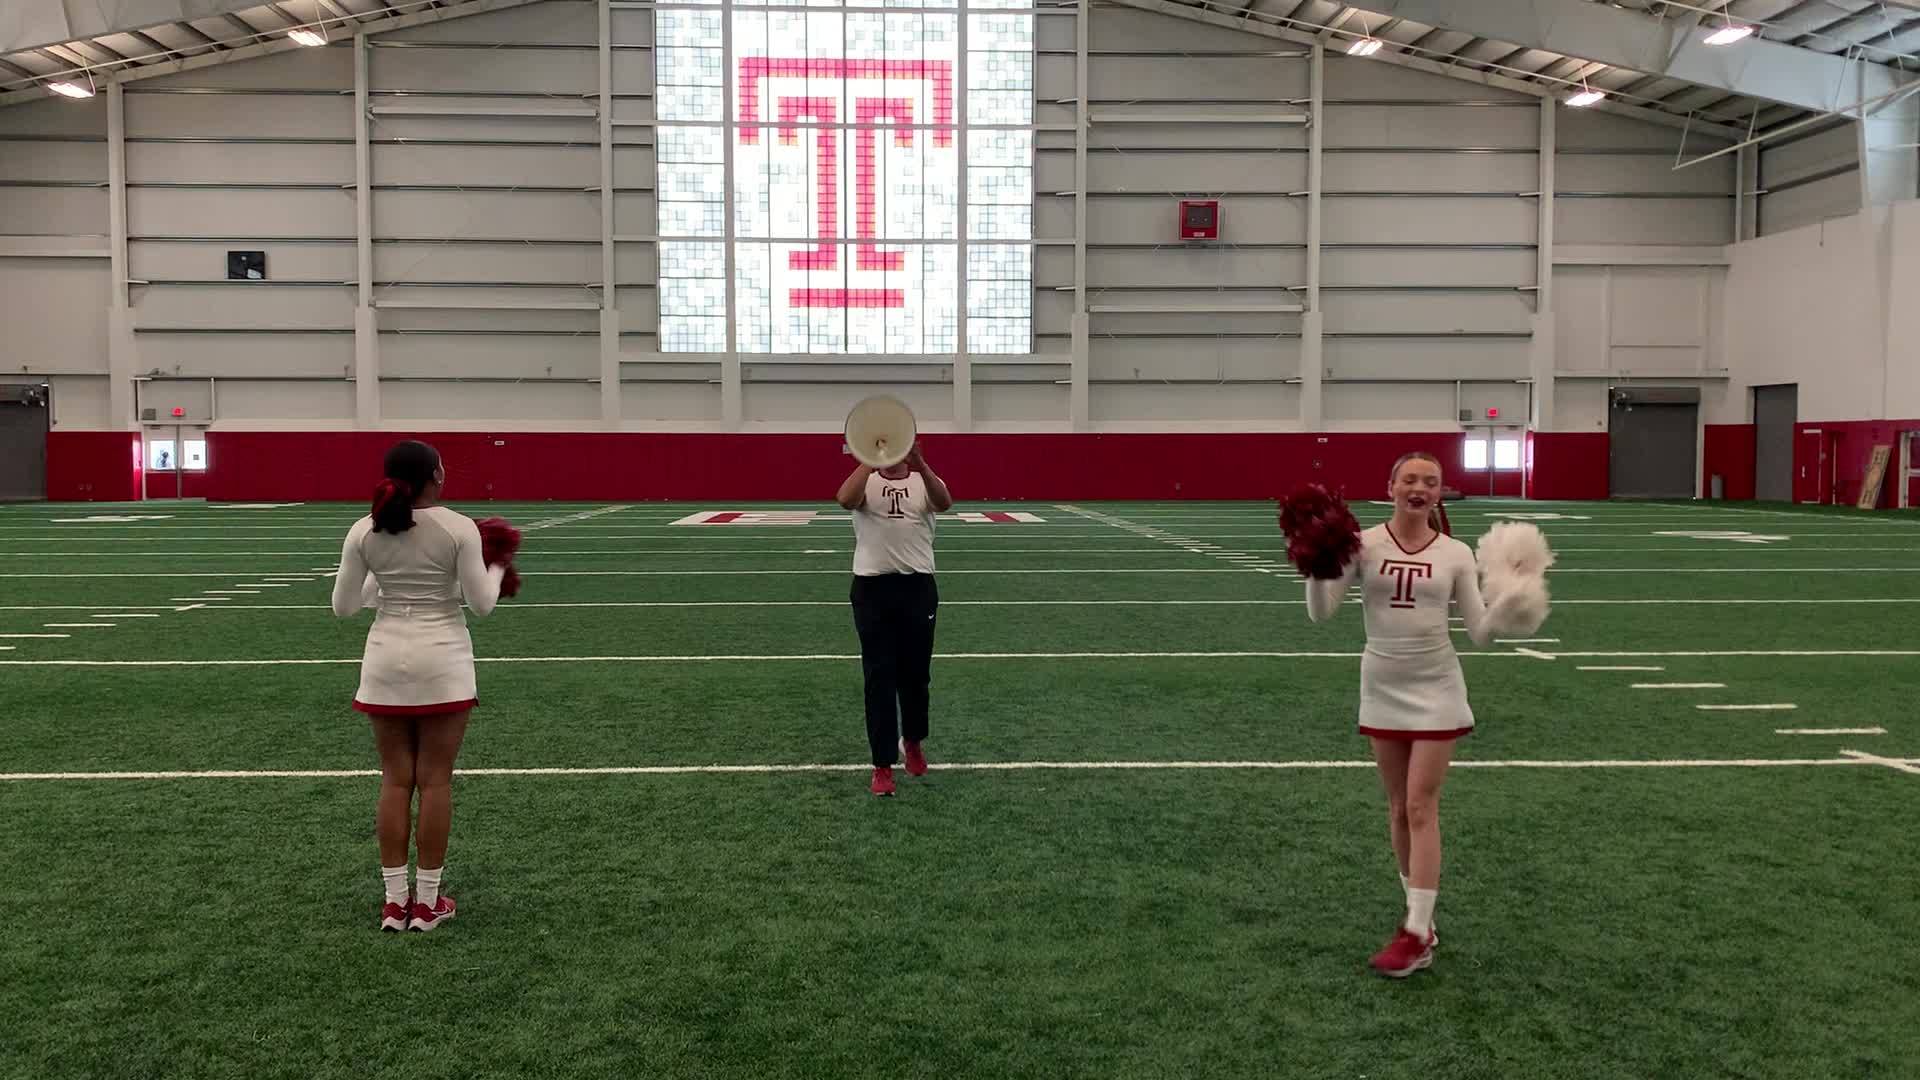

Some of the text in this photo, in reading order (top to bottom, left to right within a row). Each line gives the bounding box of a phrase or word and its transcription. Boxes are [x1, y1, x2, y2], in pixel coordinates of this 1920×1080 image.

[738, 57, 952, 308] T
[882, 486, 909, 519] T
[1379, 559, 1432, 608] T
